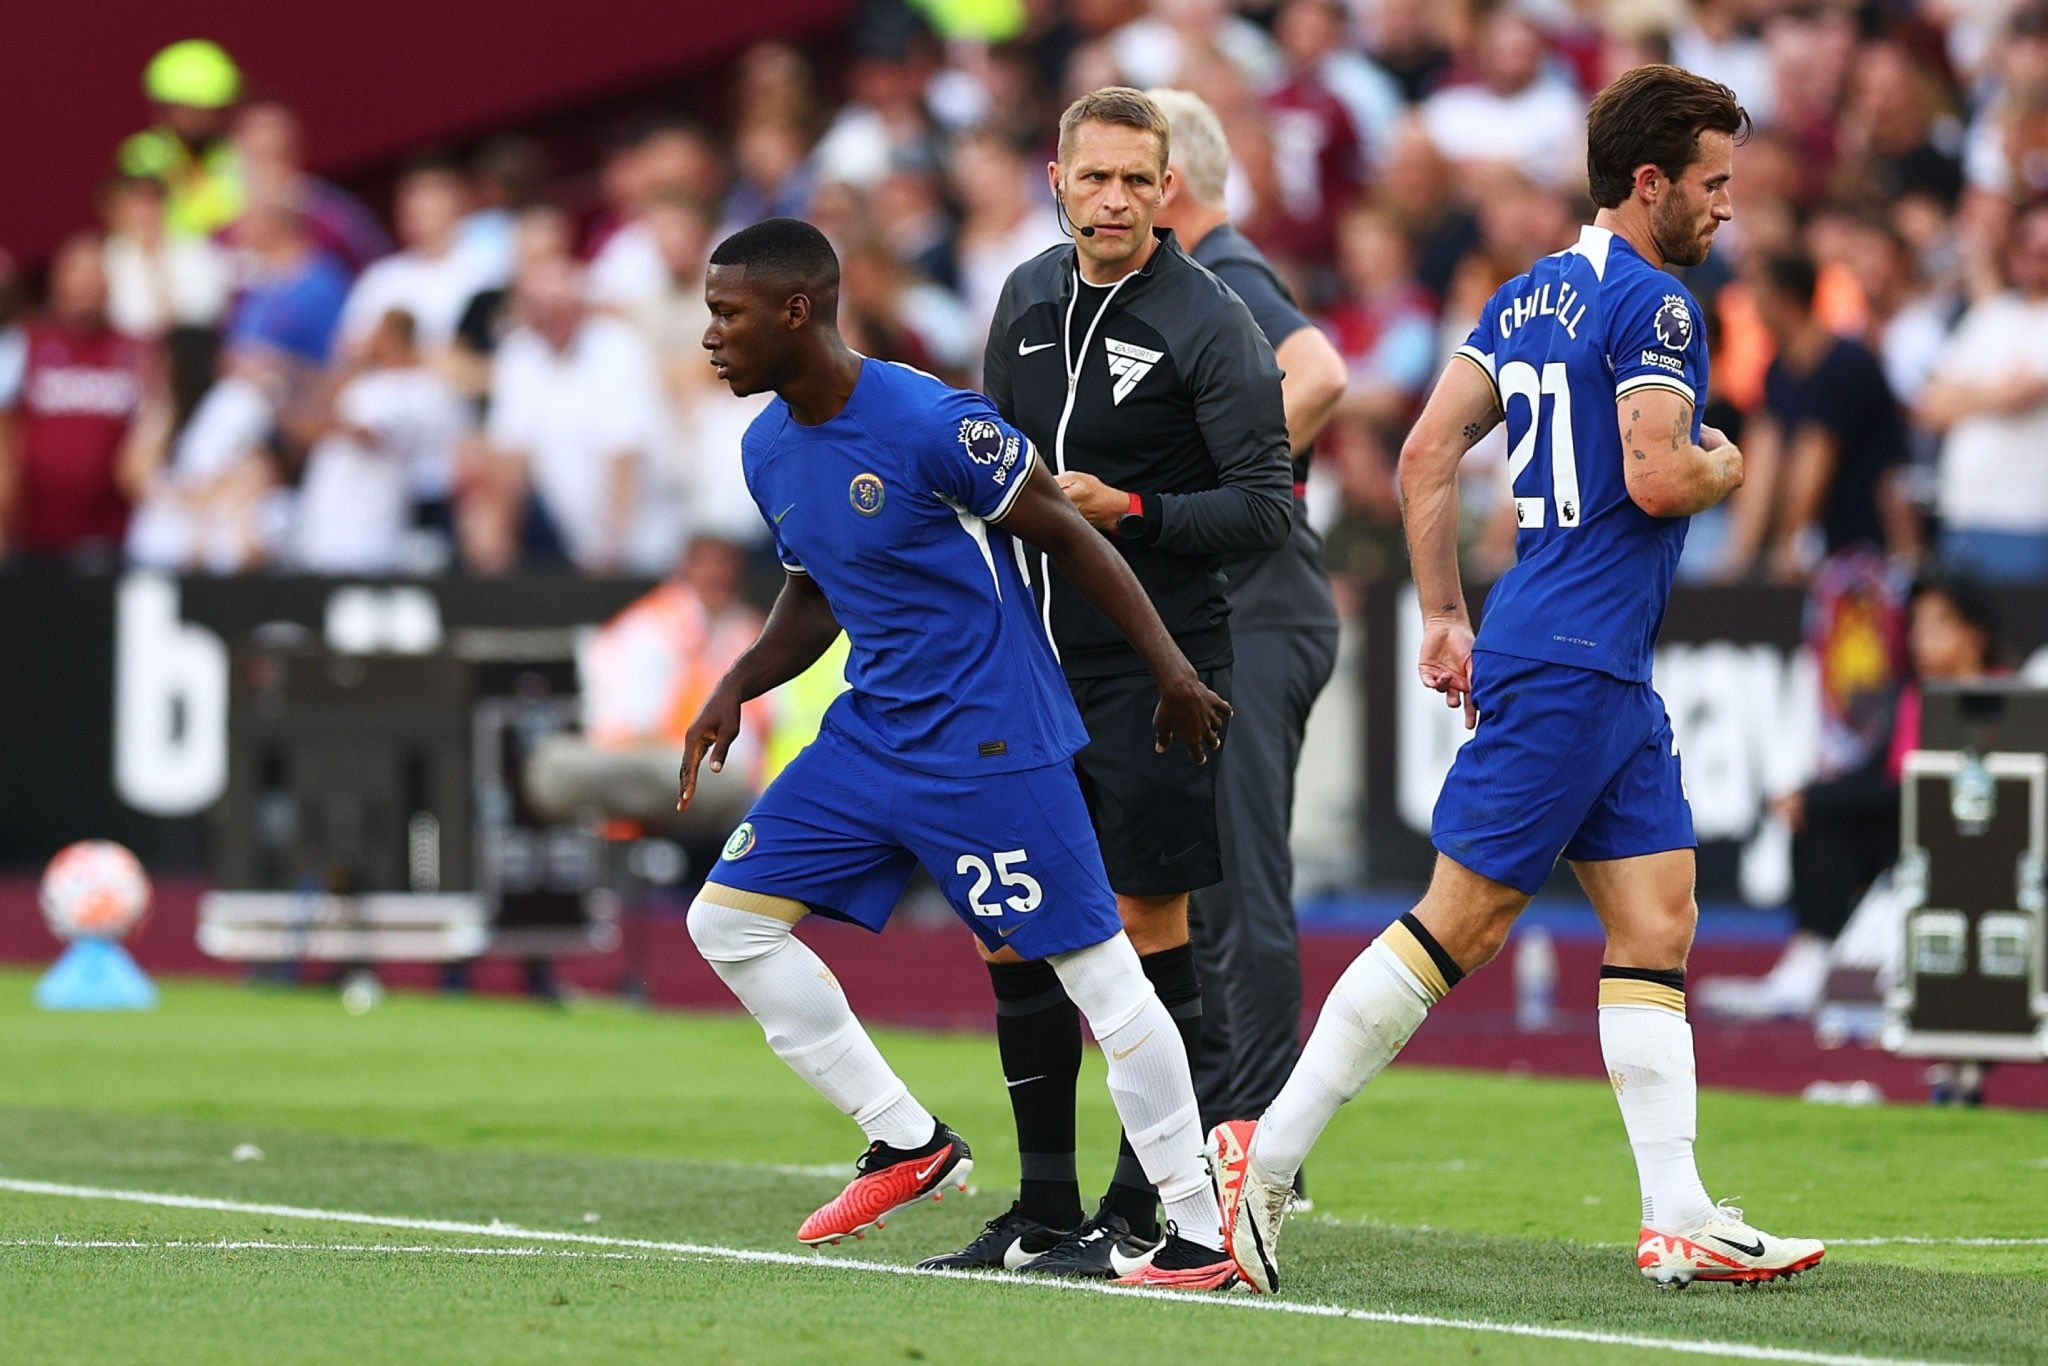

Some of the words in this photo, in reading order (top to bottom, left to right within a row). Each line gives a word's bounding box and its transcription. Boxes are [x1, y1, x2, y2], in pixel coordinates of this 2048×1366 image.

[1641, 350, 1659, 363] No
[1498, 361, 1580, 528] 21
[956, 848, 1043, 916] 25
